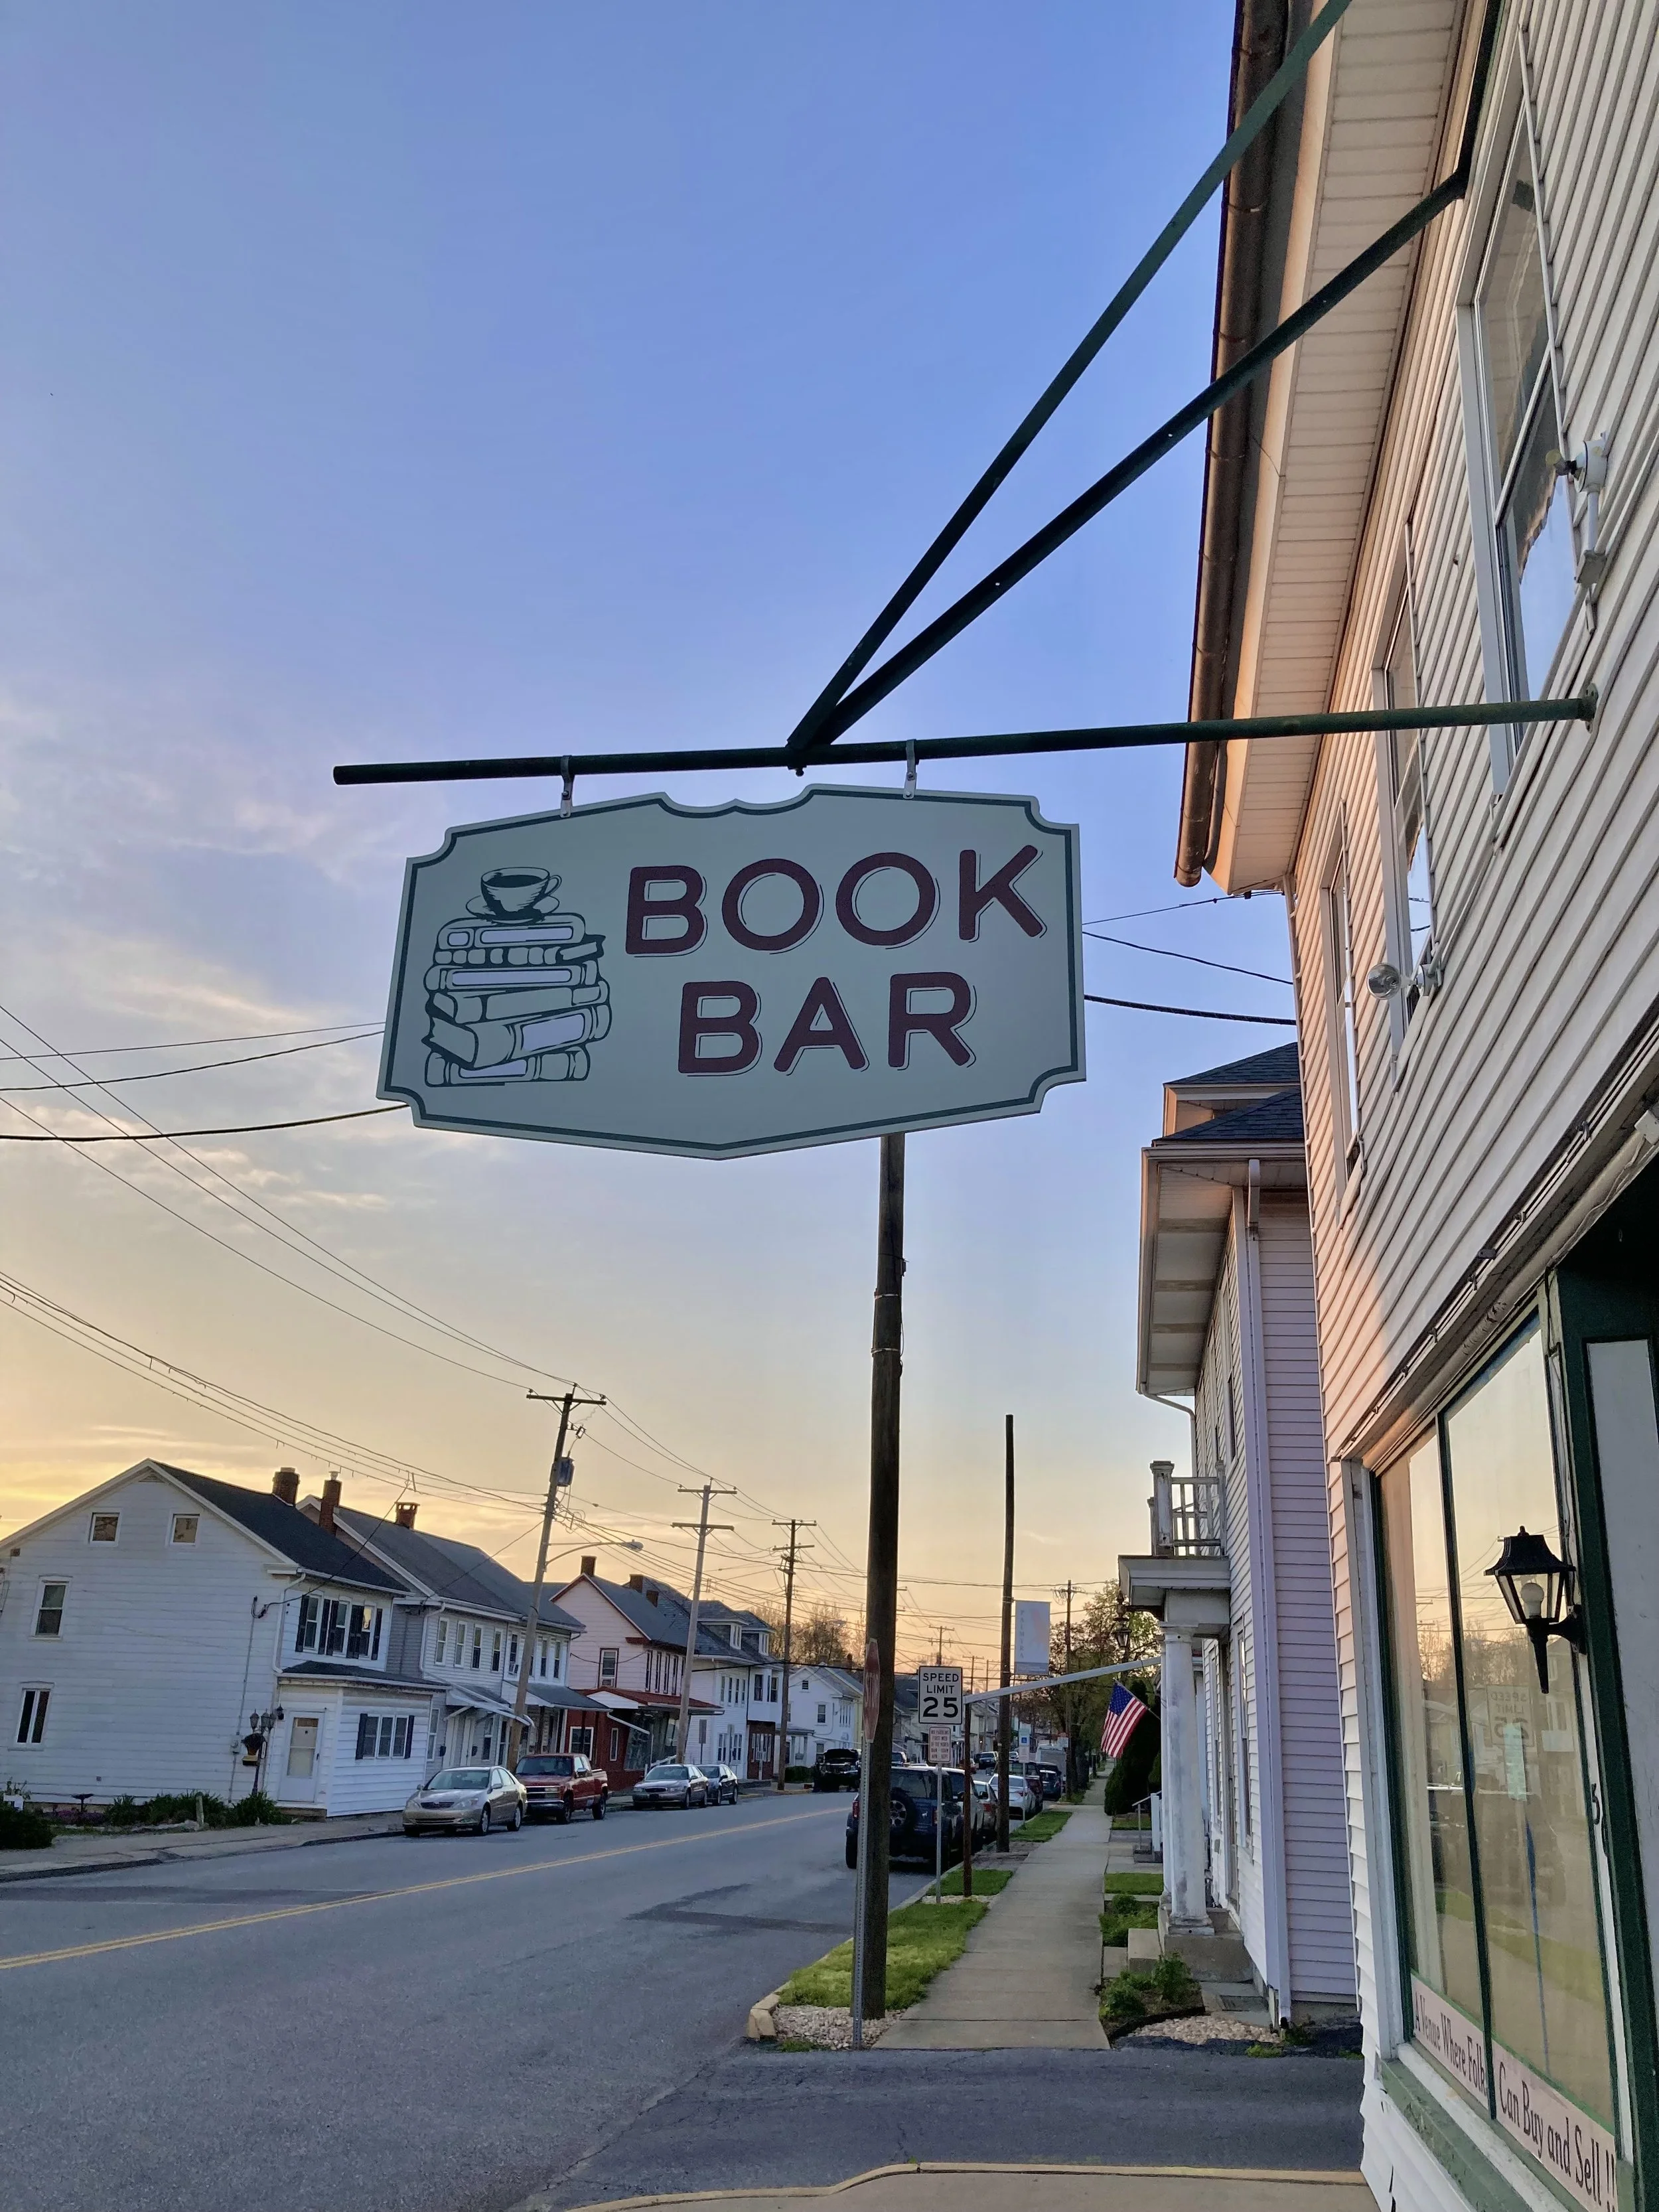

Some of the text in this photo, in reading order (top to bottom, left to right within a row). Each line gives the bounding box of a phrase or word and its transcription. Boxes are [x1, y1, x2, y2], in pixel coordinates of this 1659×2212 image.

[624, 844, 1046, 956] BOOK
[678, 972, 975, 1076] BAR
[864, 1672, 879, 1708] STOP
[923, 1673, 959, 1682] SPEED
[923, 1697, 958, 1718] 25
[927, 1685, 955, 1694] LIMIT
[1415, 1992, 1421, 2032] A
[1419, 1994, 1441, 2051] Venue
[1440, 2012, 1467, 2077] Where
[1499, 2061, 1520, 2128] Can
[1522, 2080, 1543, 2159] Buy
[1548, 2116, 1571, 2177] and
